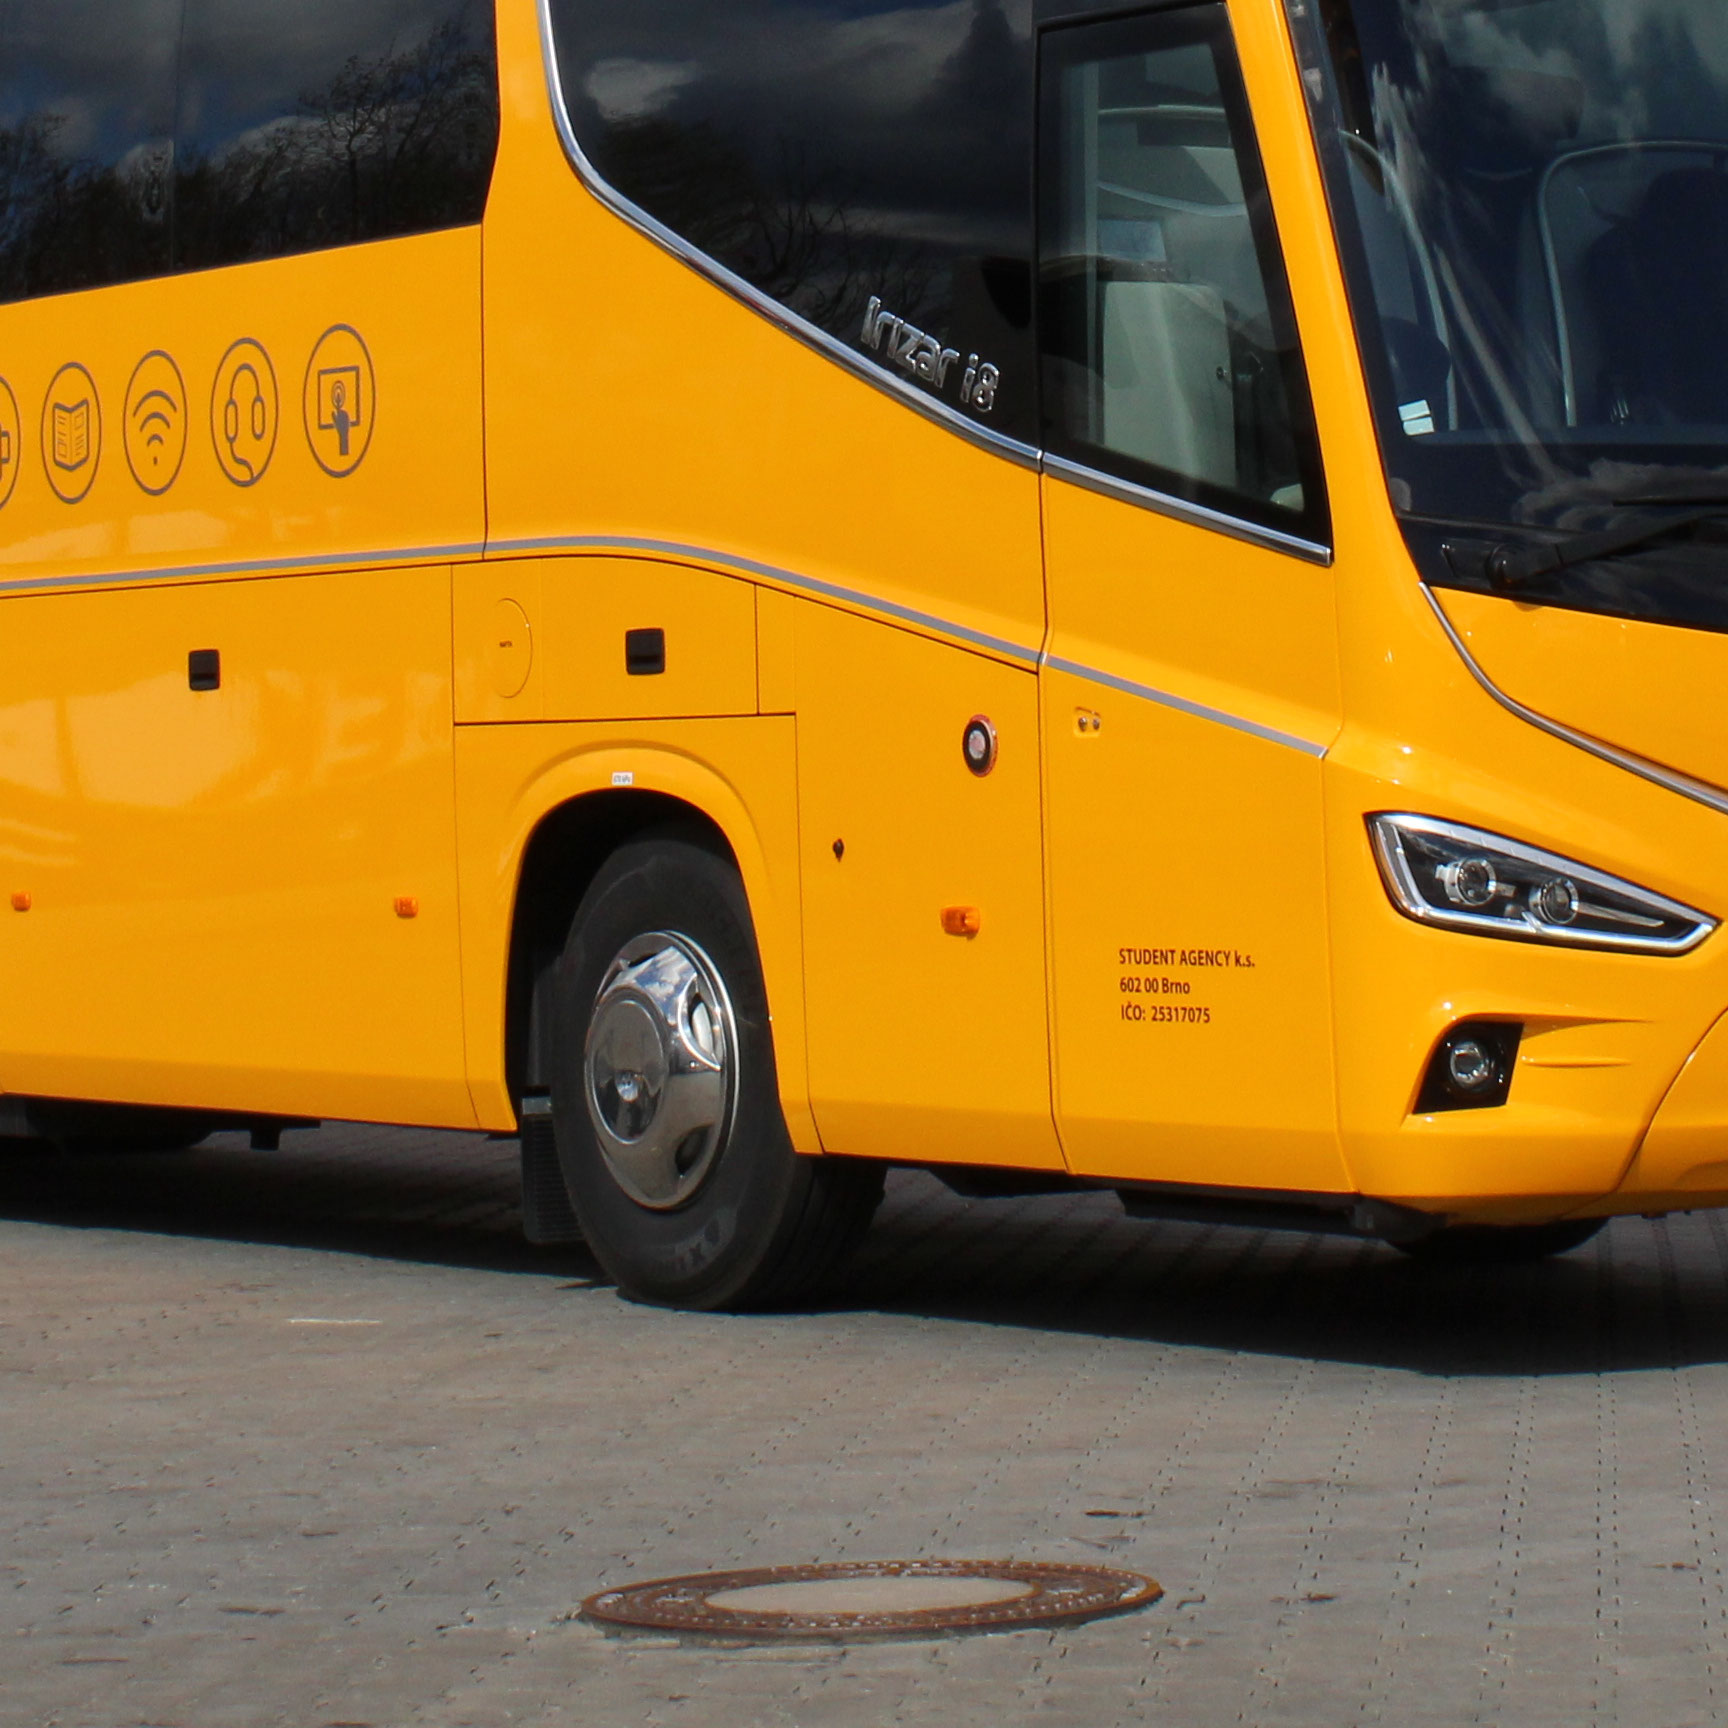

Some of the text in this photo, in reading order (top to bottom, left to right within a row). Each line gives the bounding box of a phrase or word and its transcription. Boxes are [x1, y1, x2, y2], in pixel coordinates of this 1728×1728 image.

[960, 353, 1000, 413] i8
[1119, 948, 1256, 968] STUDENT AGENCY k.s.
[1120, 977, 1191, 995] 602 00 Brno
[1121, 1001, 1211, 1023] IČO: 25317075
